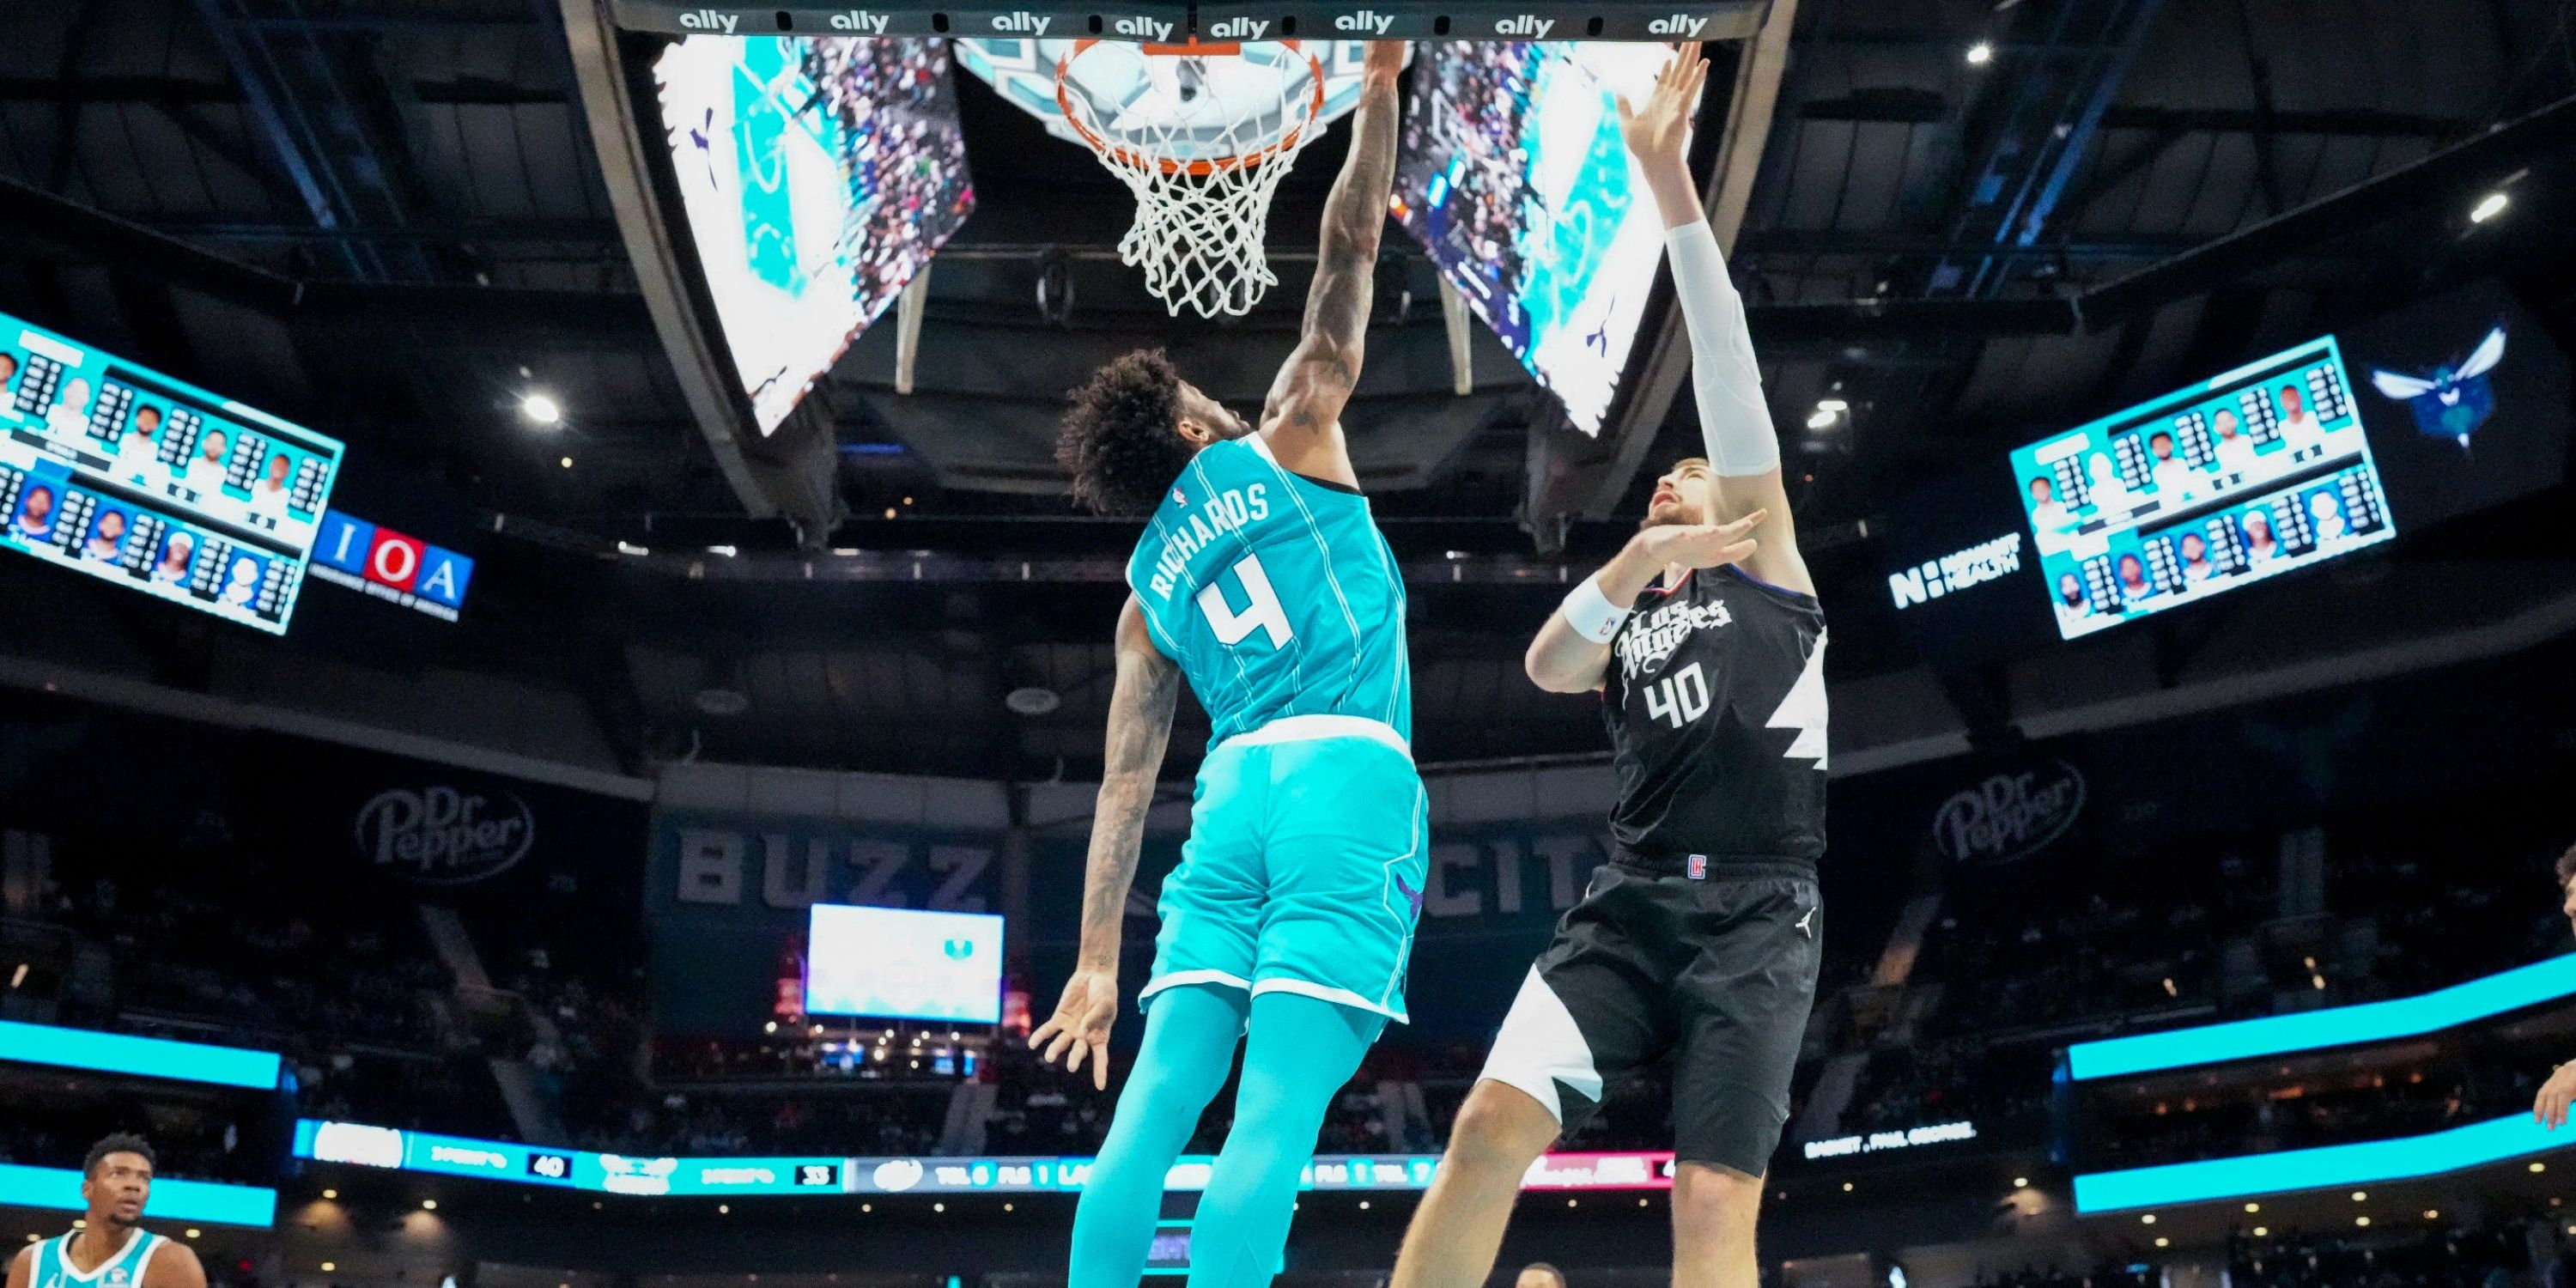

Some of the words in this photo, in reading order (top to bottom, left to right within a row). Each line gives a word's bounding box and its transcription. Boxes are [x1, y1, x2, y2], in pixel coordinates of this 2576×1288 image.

[679, 9, 738, 34] ally
[829, 9, 890, 35] ally
[992, 11, 1051, 36] ally
[1115, 15, 1174, 42] ally
[1210, 16, 1270, 40] ally
[1334, 10, 1394, 35] ally
[1495, 15, 1555, 39] ally
[1648, 14, 1709, 38] ally
[1150, 483, 1268, 601] RICHARDS
[1196, 552, 1294, 652] 4
[1631, 598, 1689, 639] Los
[1643, 661, 1710, 729] 40
[1981, 770, 2035, 814] Dr
[424, 785, 486, 829] Dr
[356, 789, 522, 872] Pepper
[677, 828, 994, 914] BUZZ
[1422, 836, 1618, 916] CIT
[534, 1156, 565, 1177] 40
